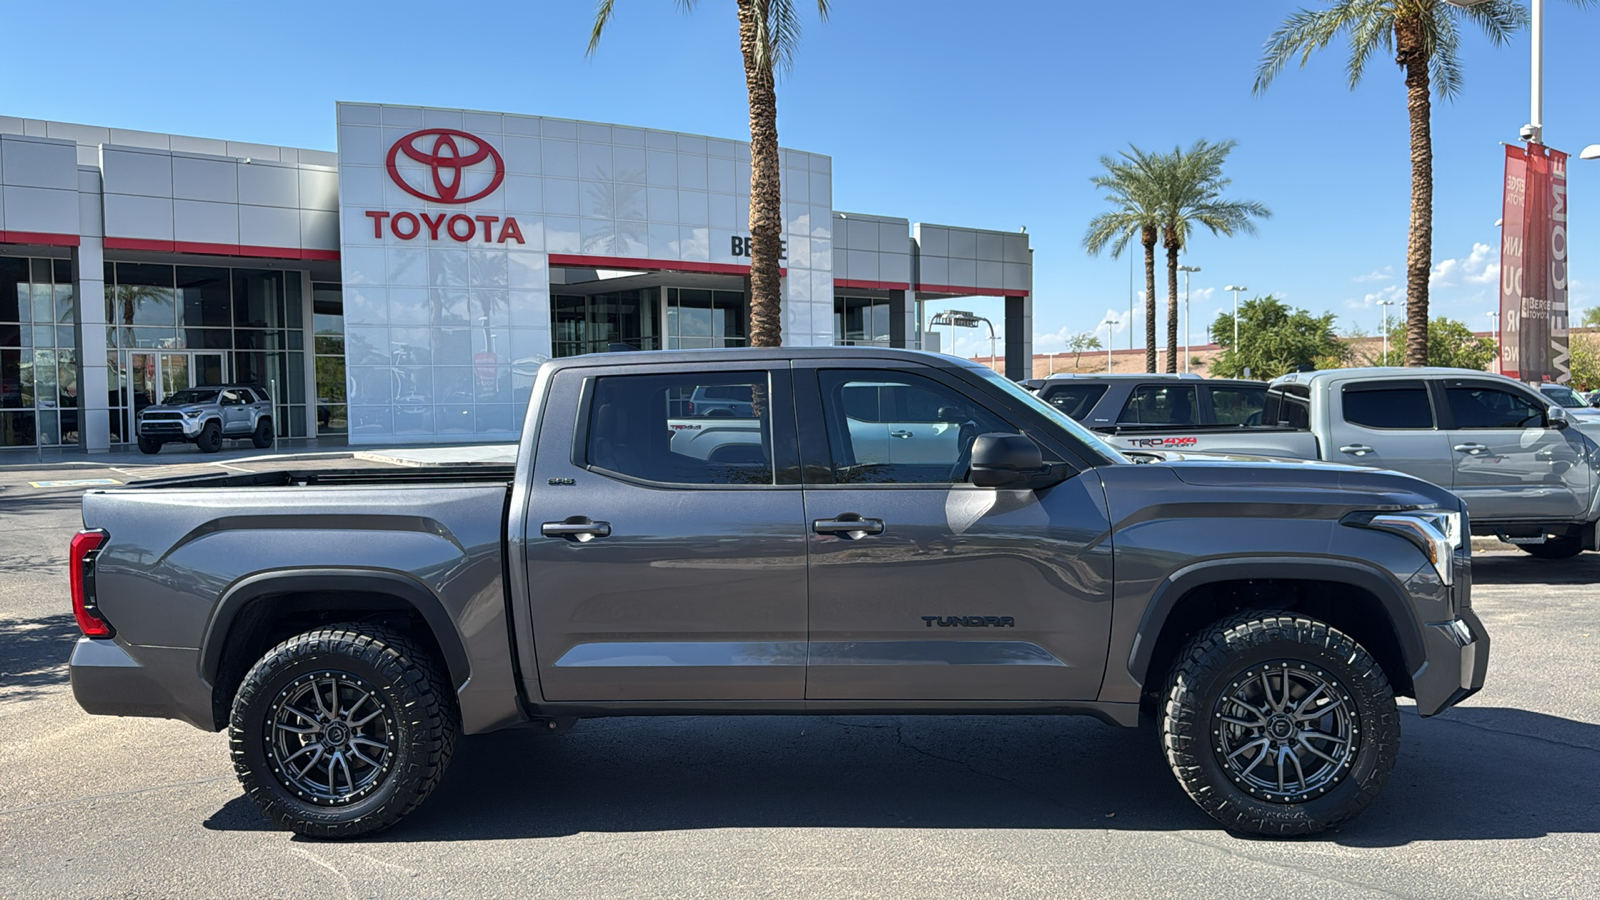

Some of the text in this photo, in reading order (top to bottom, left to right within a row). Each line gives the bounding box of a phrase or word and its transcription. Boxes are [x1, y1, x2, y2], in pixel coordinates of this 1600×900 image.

[365, 211, 525, 244] TOYOTA
[731, 235, 787, 260] BEE
[1551, 156, 1571, 383] WELCOME
[1127, 438, 1163, 448] TRD
[921, 616, 1015, 628] TUNDRA
